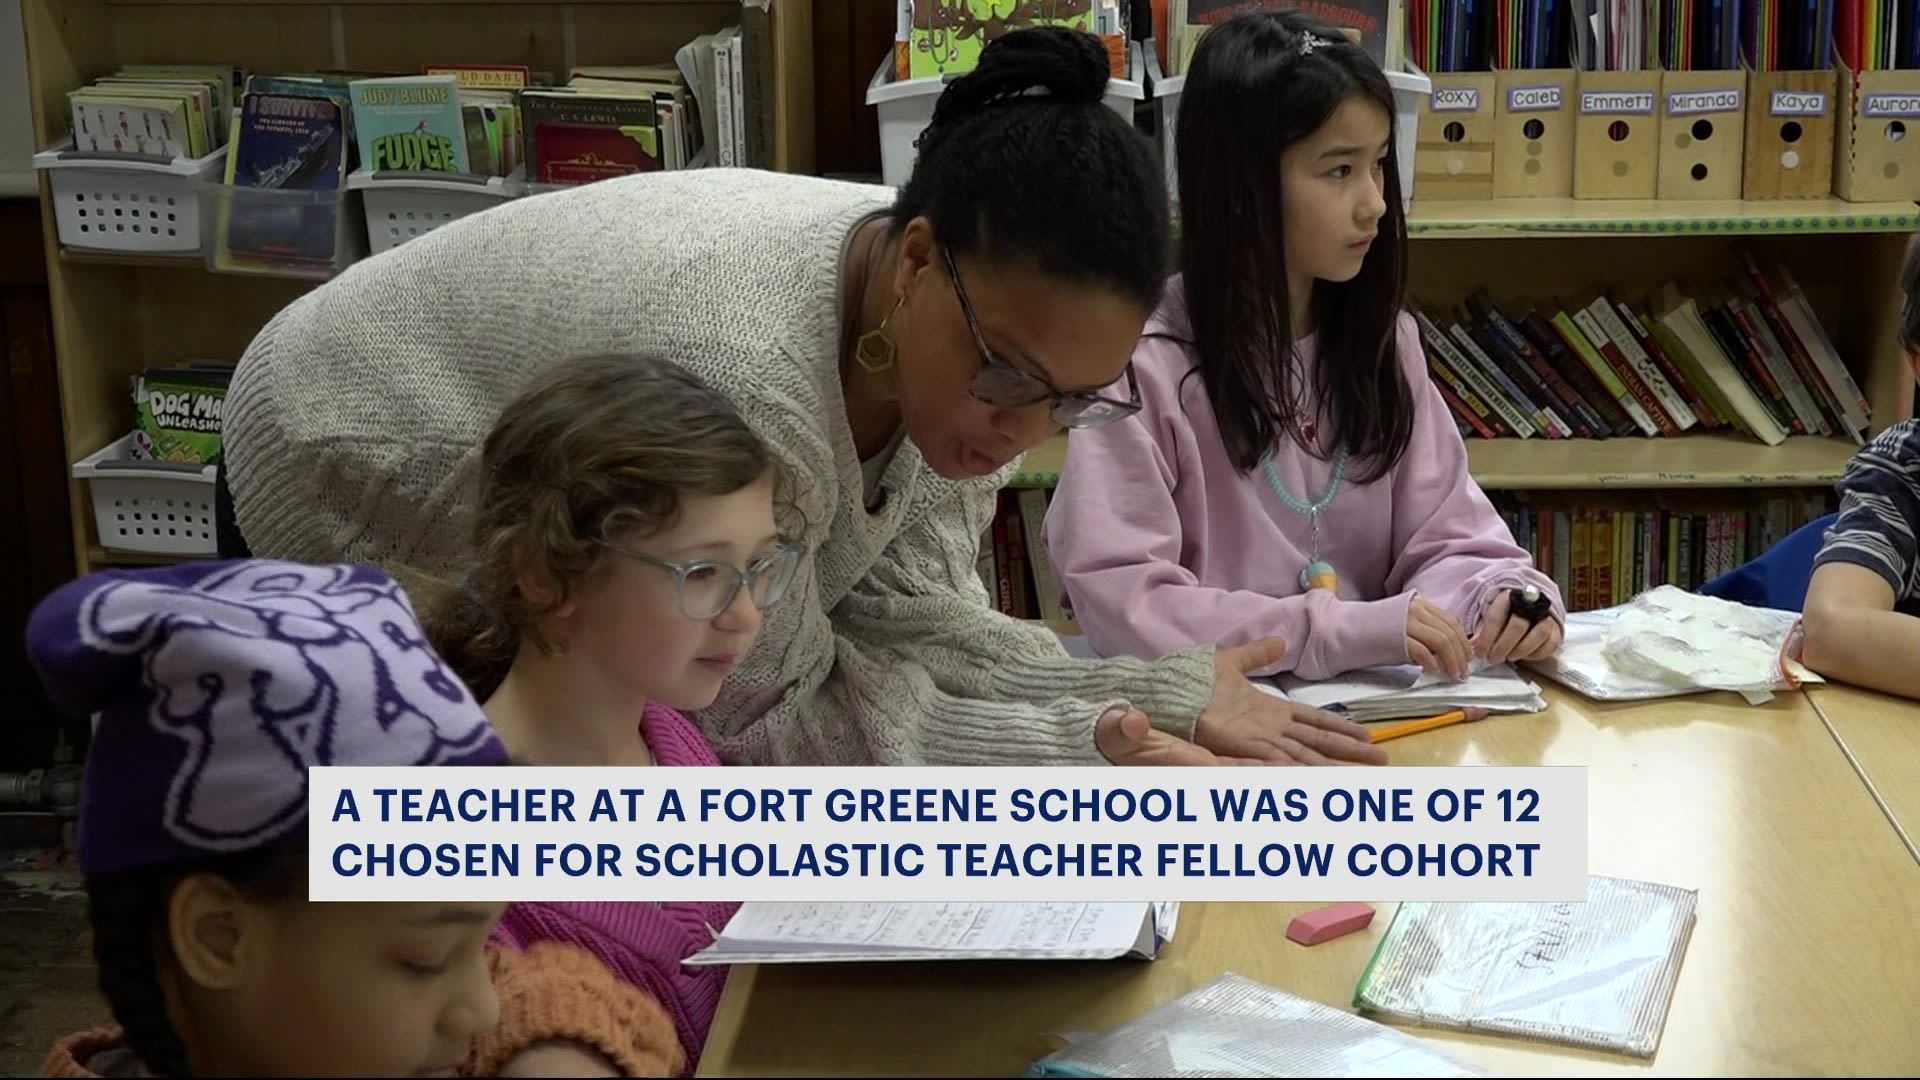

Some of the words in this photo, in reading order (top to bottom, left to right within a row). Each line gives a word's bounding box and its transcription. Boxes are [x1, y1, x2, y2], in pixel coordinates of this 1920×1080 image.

[361, 88, 396, 105] JUDY
[400, 88, 448, 105] BLUME
[1435, 90, 1476, 106] Roxy
[1514, 90, 1560, 106] Caleb
[1583, 95, 1650, 109] Emmett
[1671, 94, 1737, 108] Miranda
[1776, 95, 1819, 111] Kaya
[1870, 98, 1920, 110] Auror
[372, 133, 458, 171] FUDGE
[150, 390, 190, 417] DOG
[192, 394, 221, 419] MA
[157, 414, 222, 431] UNLEASHE
